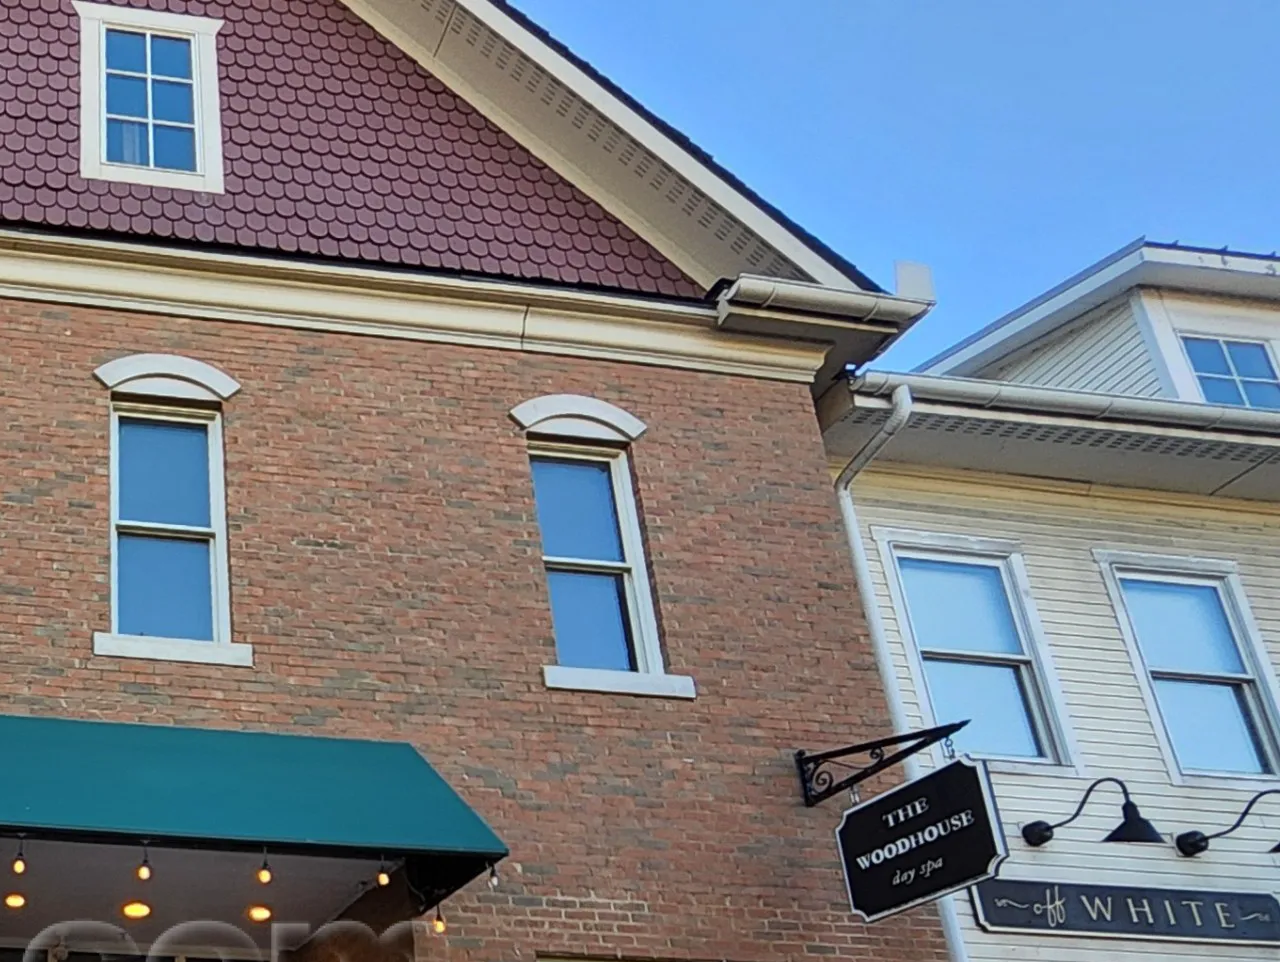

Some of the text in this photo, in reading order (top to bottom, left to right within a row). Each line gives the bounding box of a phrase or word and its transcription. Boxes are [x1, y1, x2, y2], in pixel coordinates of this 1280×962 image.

[882, 797, 930, 828] THE
[856, 810, 975, 871] WOODHOUSE
[892, 857, 944, 886] day spa
[1033, 885, 1236, 928] off WHITE
